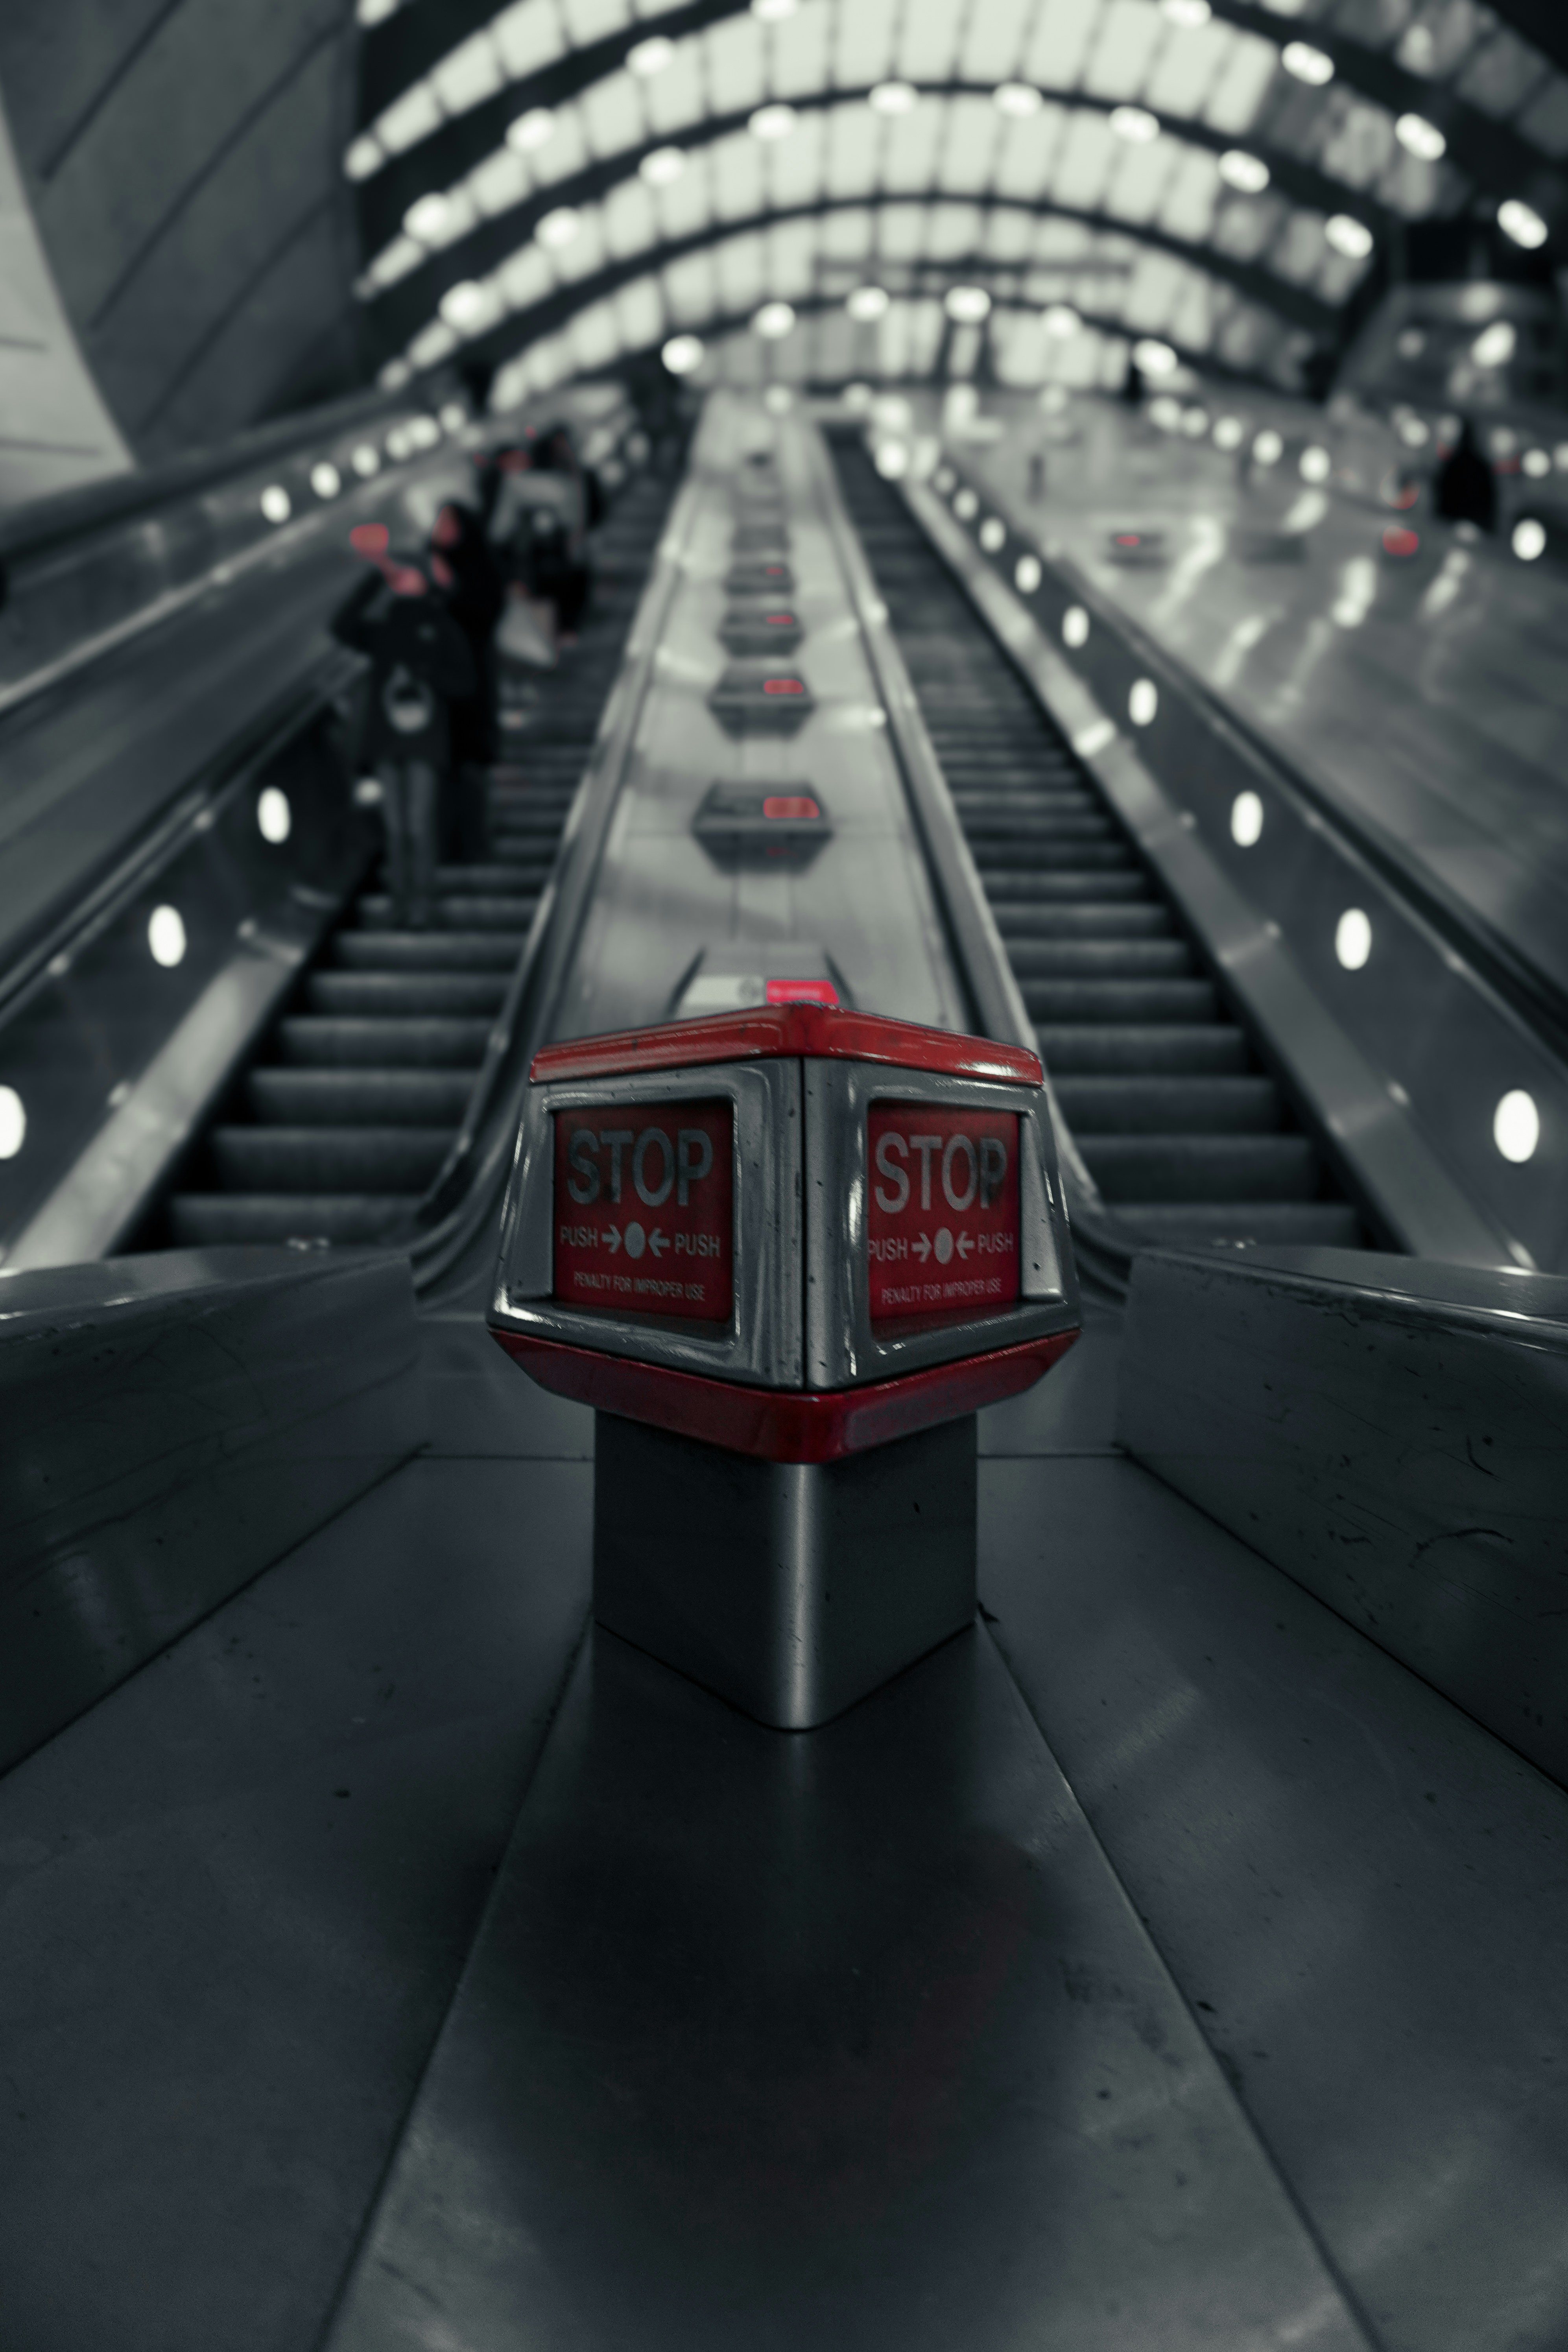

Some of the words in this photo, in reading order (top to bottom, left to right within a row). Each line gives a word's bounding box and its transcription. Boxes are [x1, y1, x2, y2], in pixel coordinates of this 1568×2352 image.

[568, 1127, 713, 1206] STOP
[875, 1132, 1007, 1213] STOP
[560, 1226, 598, 1247] PUSH
[675, 1233, 720, 1257] PUSH
[979, 1232, 1013, 1253] PUSH
[574, 1271, 611, 1289] PENALTY
[613, 1275, 632, 1293] FOR
[633, 1277, 684, 1299] IMPROPER
[684, 1283, 705, 1301] USE
[881, 1286, 921, 1305] PENALTY
[923, 1283, 942, 1301] FOR
[943, 1279, 985, 1297] IMPROPER
[986, 1277, 1002, 1294] USE
